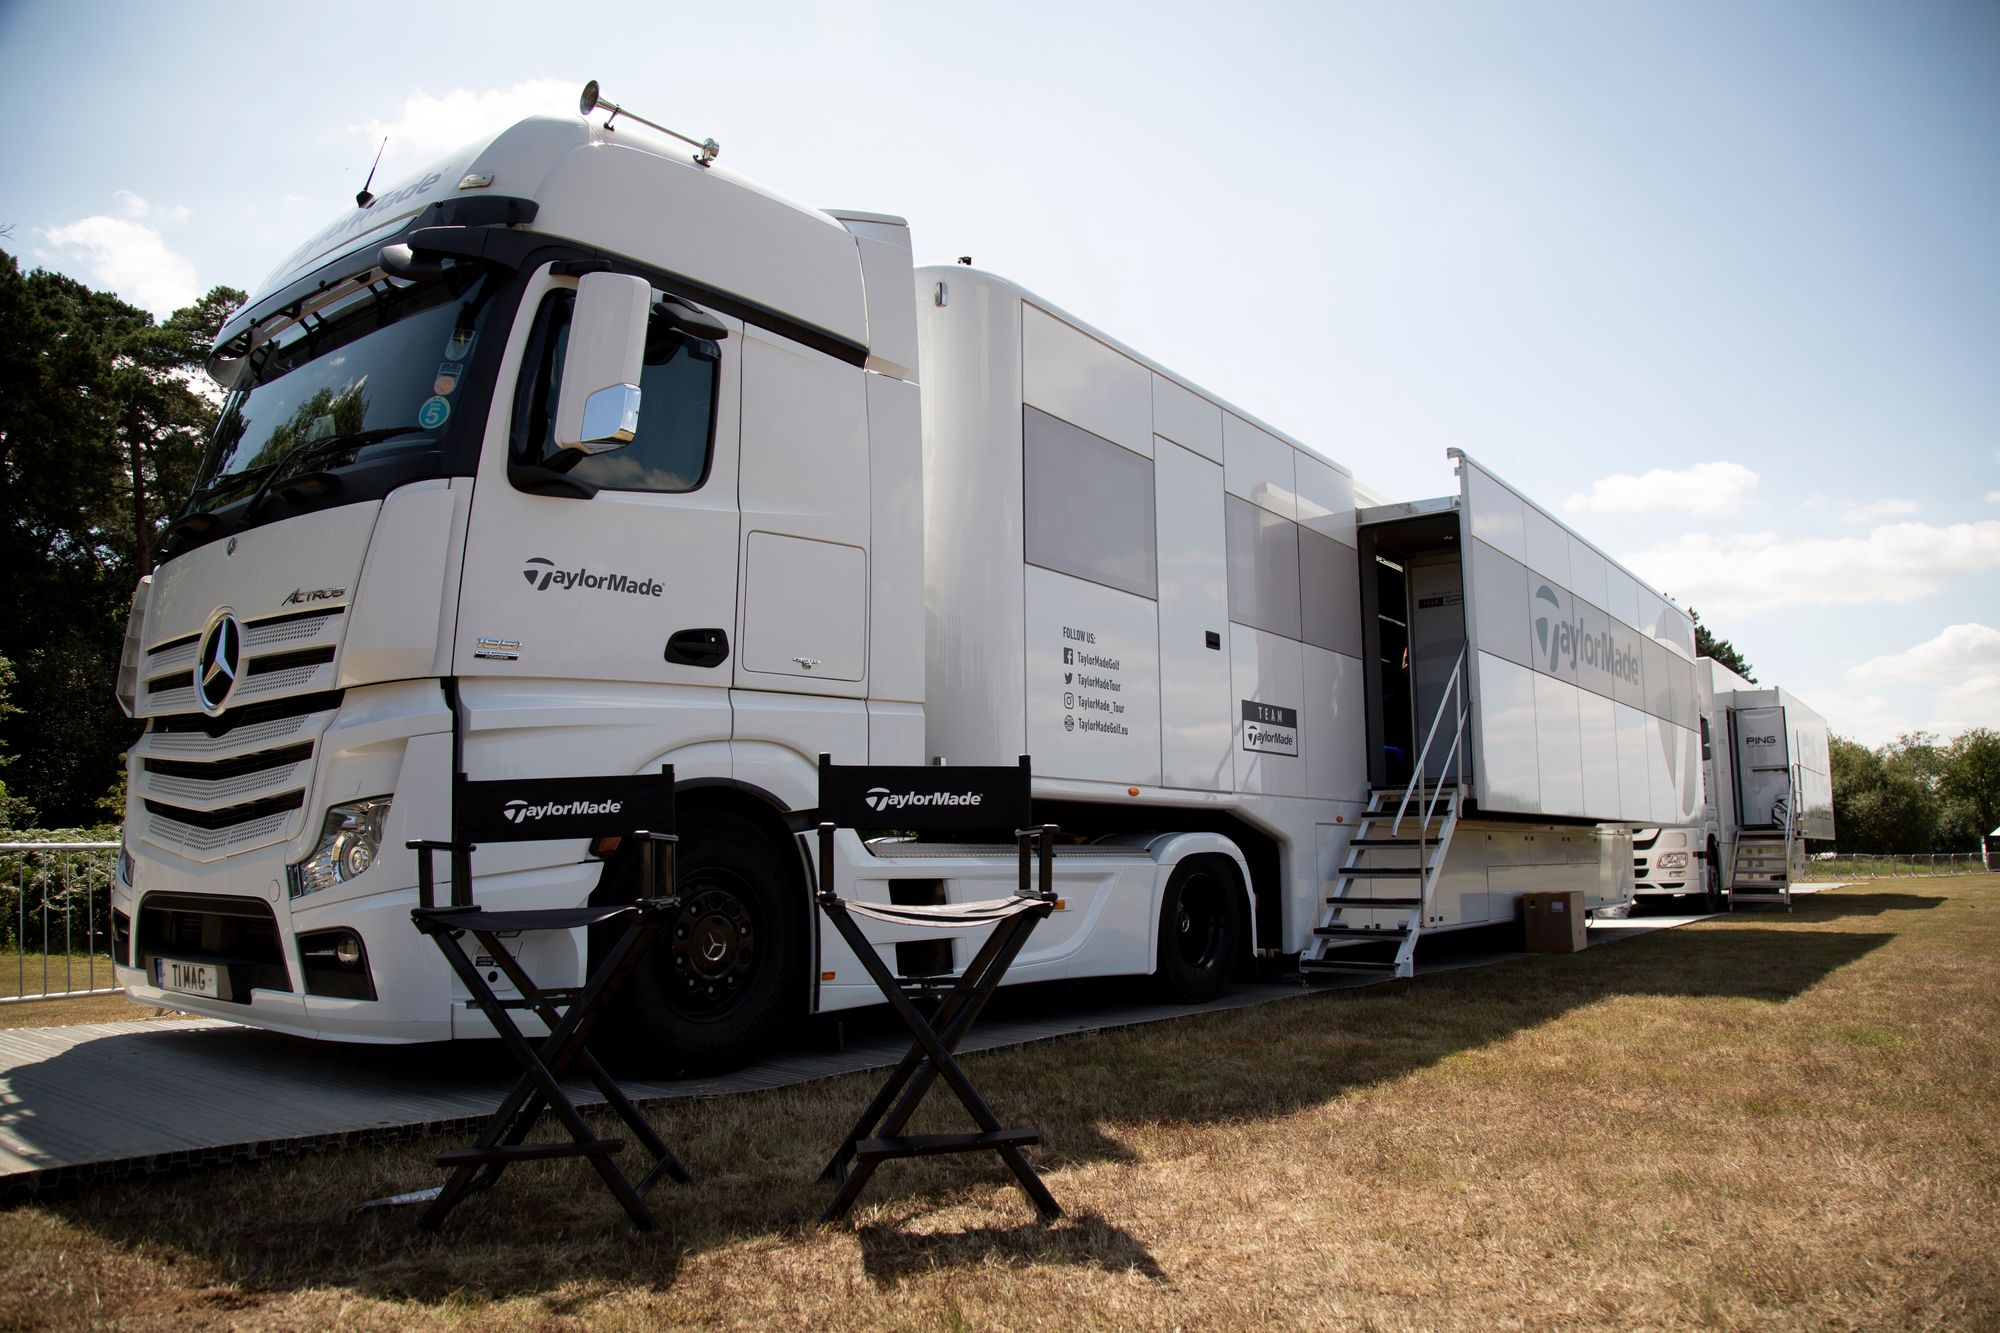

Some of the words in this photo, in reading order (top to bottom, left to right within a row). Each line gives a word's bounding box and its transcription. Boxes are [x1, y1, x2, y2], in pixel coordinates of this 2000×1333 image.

[425, 407, 441, 424] 5
[523, 557, 663, 597] TaylorMade
[1063, 626, 1086, 642] FOLLOW
[1087, 632, 1096, 645] US:
[1535, 585, 1639, 686] TaylorMade
[1077, 651, 1120, 671] TaylorMadeGolf
[1078, 673, 1121, 692] TaylorMadeTour
[1078, 695, 1125, 714] TaylorMade_Tour
[1257, 706, 1283, 723] TEAM
[1078, 717, 1129, 736] TaylorMadeGolf.eu
[1247, 725, 1293, 746] TaylorMade
[1746, 736, 1776, 745] PING
[865, 786, 982, 812] TaylorMade
[503, 799, 623, 824] TaylorMade
